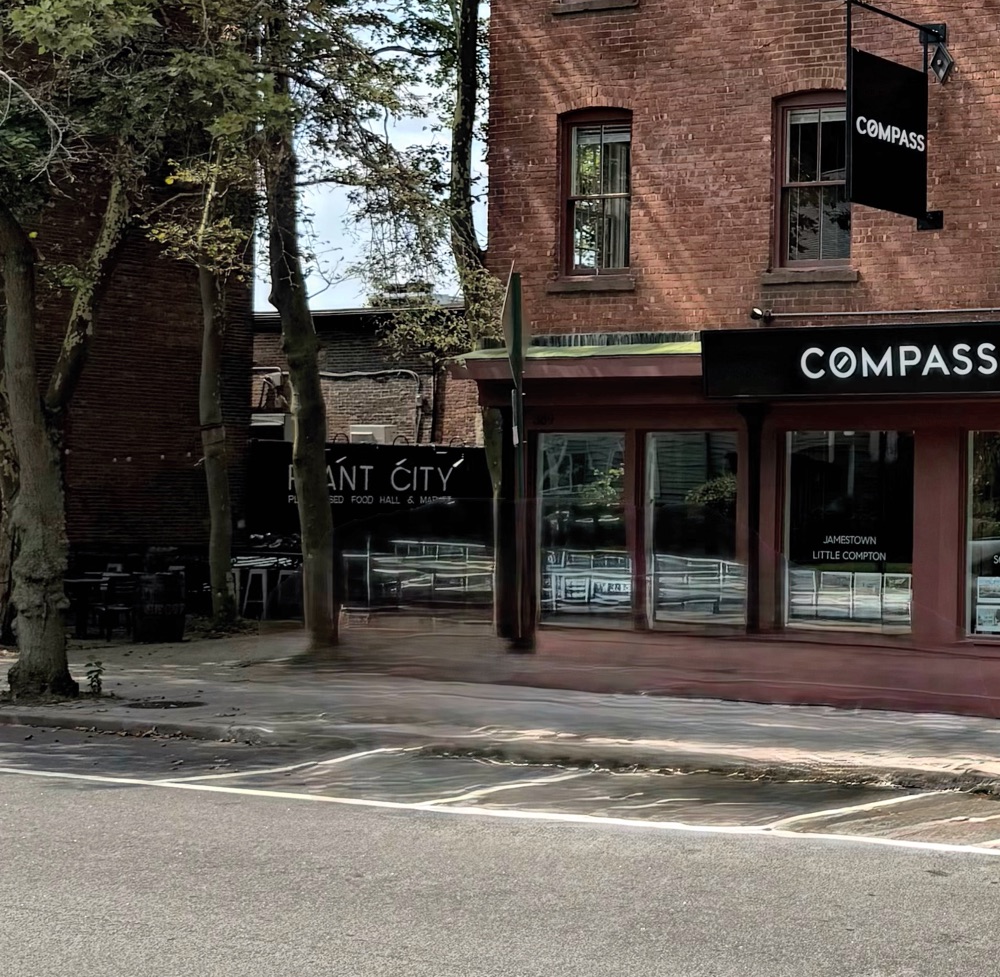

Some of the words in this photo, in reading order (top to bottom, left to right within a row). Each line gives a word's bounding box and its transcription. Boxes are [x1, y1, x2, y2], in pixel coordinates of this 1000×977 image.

[856, 115, 926, 152] COMPASS
[801, 342, 998, 379] COMPASS
[391, 465, 453, 491] CITY
[351, 495, 374, 504] FOOD
[379, 495, 401, 504] HALL
[407, 495, 415, 504] &
[823, 535, 877, 545] JAMESTOWN
[812, 550, 841, 560] LITTLE
[842, 550, 887, 561] COMPTON
